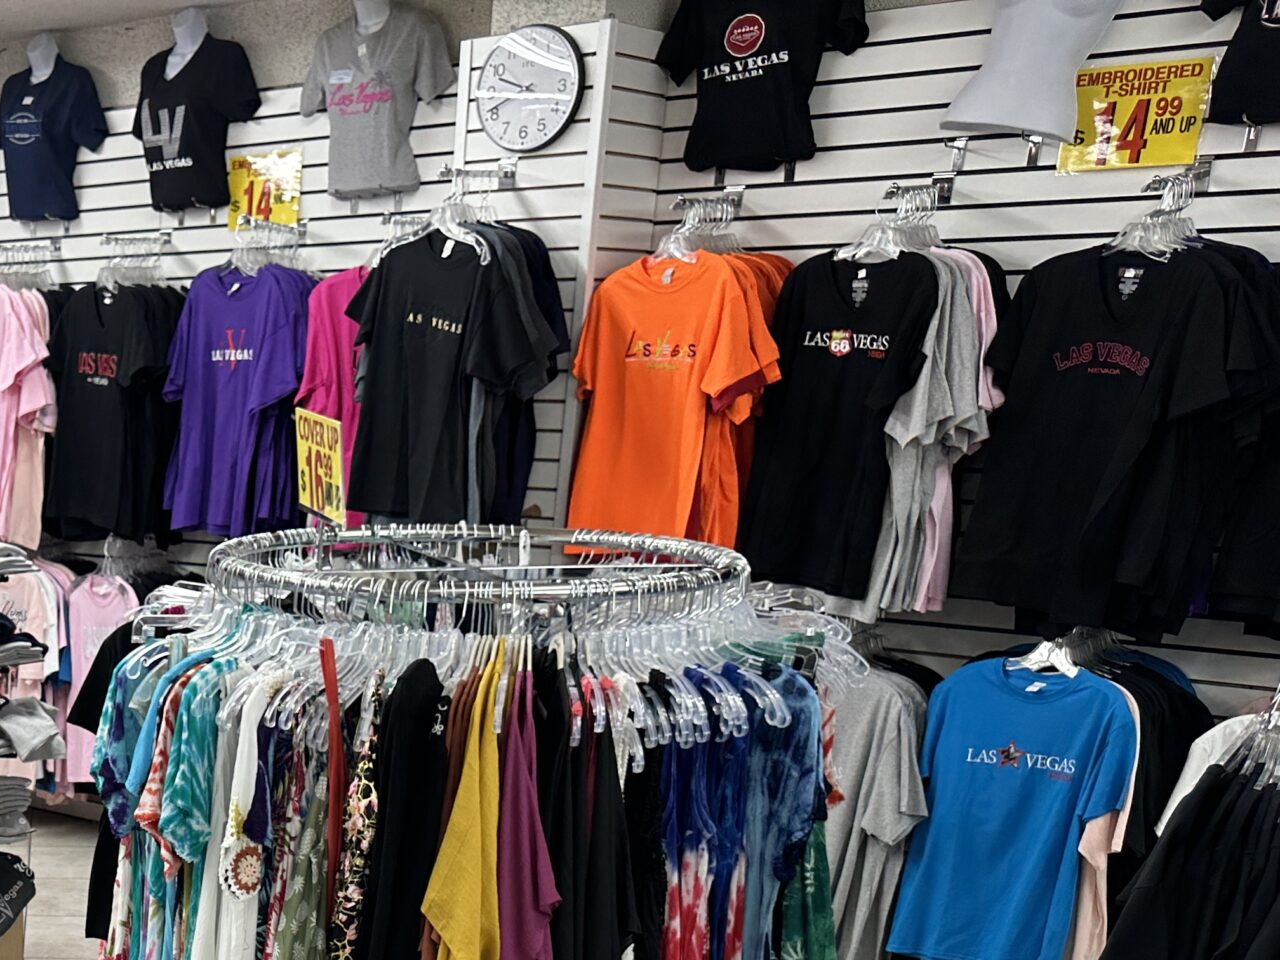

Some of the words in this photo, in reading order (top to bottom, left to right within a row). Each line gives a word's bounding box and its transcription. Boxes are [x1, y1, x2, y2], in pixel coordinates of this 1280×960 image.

[492, 62, 506, 78] 10
[703, 62, 731, 80] LAS
[734, 50, 789, 71] VEGAS
[725, 68, 764, 82] NEVADA
[1076, 62, 1205, 88] EMBROIDERED
[557, 78, 567, 93] 3
[1102, 79, 1172, 99] T-SHIRT
[489, 106, 500, 121] 8
[502, 121, 511, 135] 7
[519, 125, 529, 139] 6
[537, 118, 547, 132] 5
[1149, 117, 1175, 136] AND
[1179, 115, 1197, 134] UP
[431, 316, 463, 335] VEGAS
[803, 330, 830, 347] LAS
[830, 339, 851, 353] 66
[852, 333, 890, 351] VEGAS
[1052, 342, 1093, 372] LAS
[1096, 341, 1151, 377] VEGAS
[1087, 366, 1121, 375] NEVADA
[298, 414, 326, 449] COVER
[326, 423, 340, 453] UP
[306, 445, 325, 512] 16
[966, 747, 998, 765] LAS
[1025, 753, 1077, 775] VEGAS
